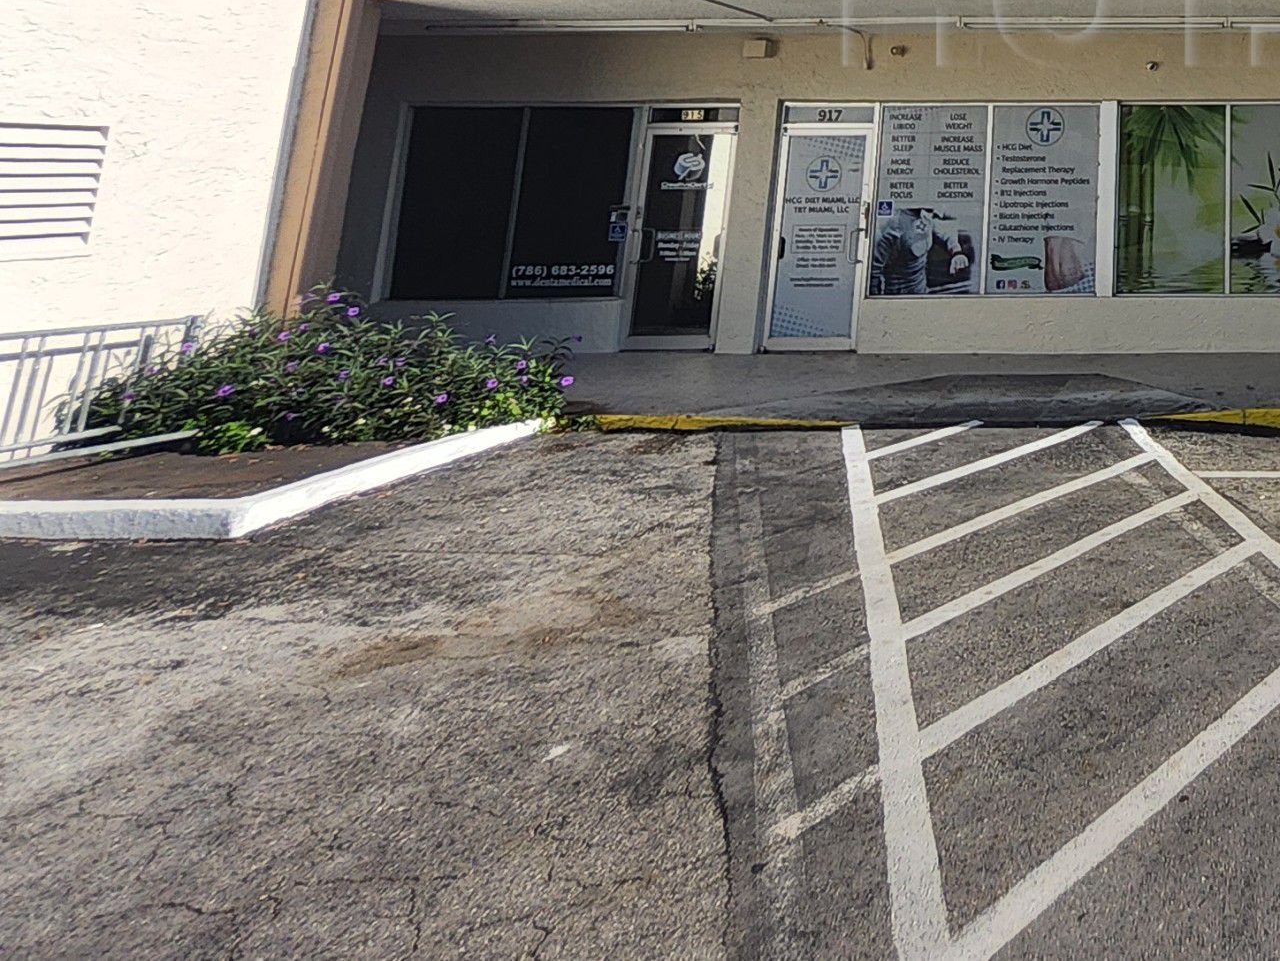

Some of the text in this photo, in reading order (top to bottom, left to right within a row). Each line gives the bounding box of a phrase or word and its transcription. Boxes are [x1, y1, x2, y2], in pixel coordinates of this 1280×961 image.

[818, 109, 843, 122] 917
[889, 113, 922, 121] INCREASE
[950, 113, 967, 121] LOSE
[1001, 143, 1033, 151] HCG Diet
[1002, 166, 1076, 175] Replacement Therapy
[889, 181, 915, 189] BETTER
[943, 181, 969, 189] BETTER
[1060, 178, 1090, 186] Peptides
[890, 191, 913, 199] FOCUS
[937, 191, 974, 199] DIGESTION
[1000, 189, 1047, 198] B12 Injections
[821, 197, 847, 205] MIAMI,
[999, 201, 1069, 209] Lipotropic Injections
[998, 212, 1055, 221] Biotin Injections
[998, 224, 1075, 232] Glutathione Injections
[1007, 236, 1035, 244] Therapy
[512, 265, 615, 277] (786) 683-2596
